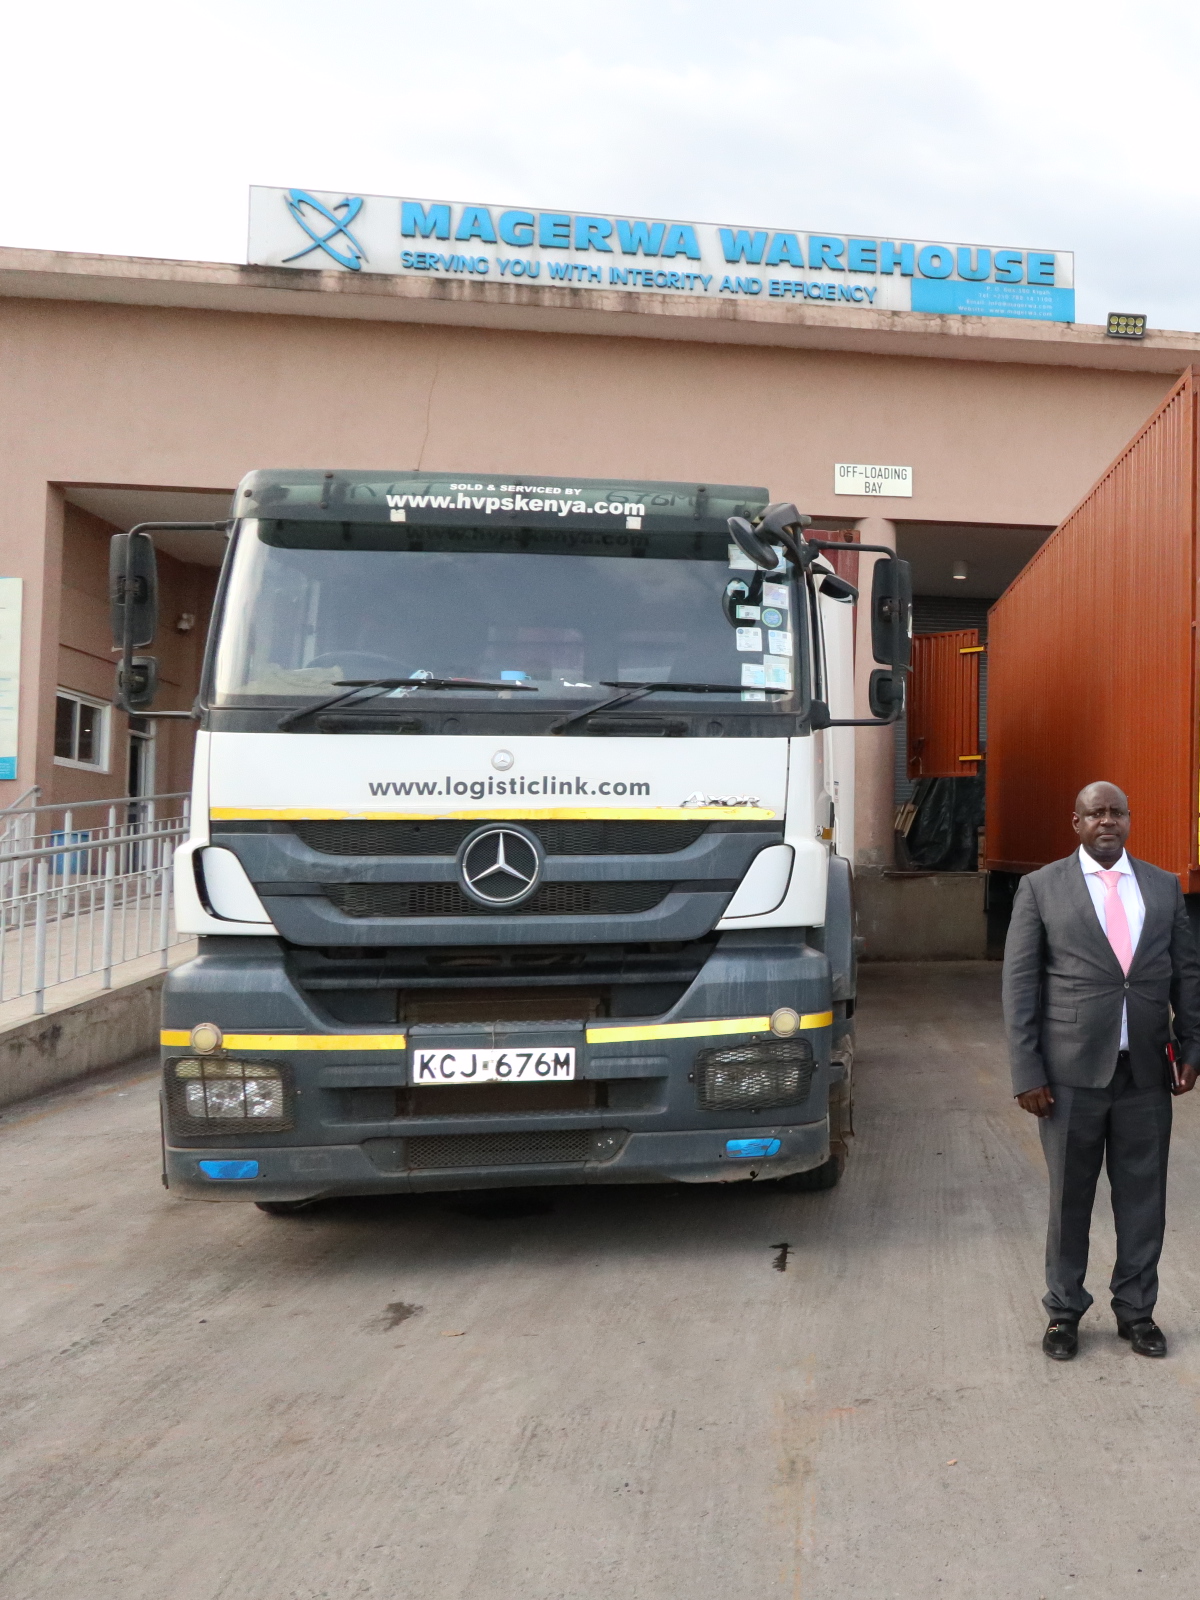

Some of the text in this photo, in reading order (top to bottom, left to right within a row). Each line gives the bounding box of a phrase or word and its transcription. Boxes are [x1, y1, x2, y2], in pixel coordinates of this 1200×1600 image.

[401, 201, 1055, 286] MAGERWA WAREHOUSE
[401, 250, 877, 304] SERVING YOU WITH INTEGRITY AND EFFICIENCY
[839, 465, 908, 480] OFF-LOADING
[449, 483, 483, 491] SOLD
[500, 485, 562, 494] SERVICED
[565, 487, 582, 496] BY
[864, 481, 883, 494] BAY
[386, 492, 646, 517] www.hvpskenya.com
[368, 776, 650, 800] www.logisticlink.com
[418, 1052, 571, 1079] KCJ 676M
